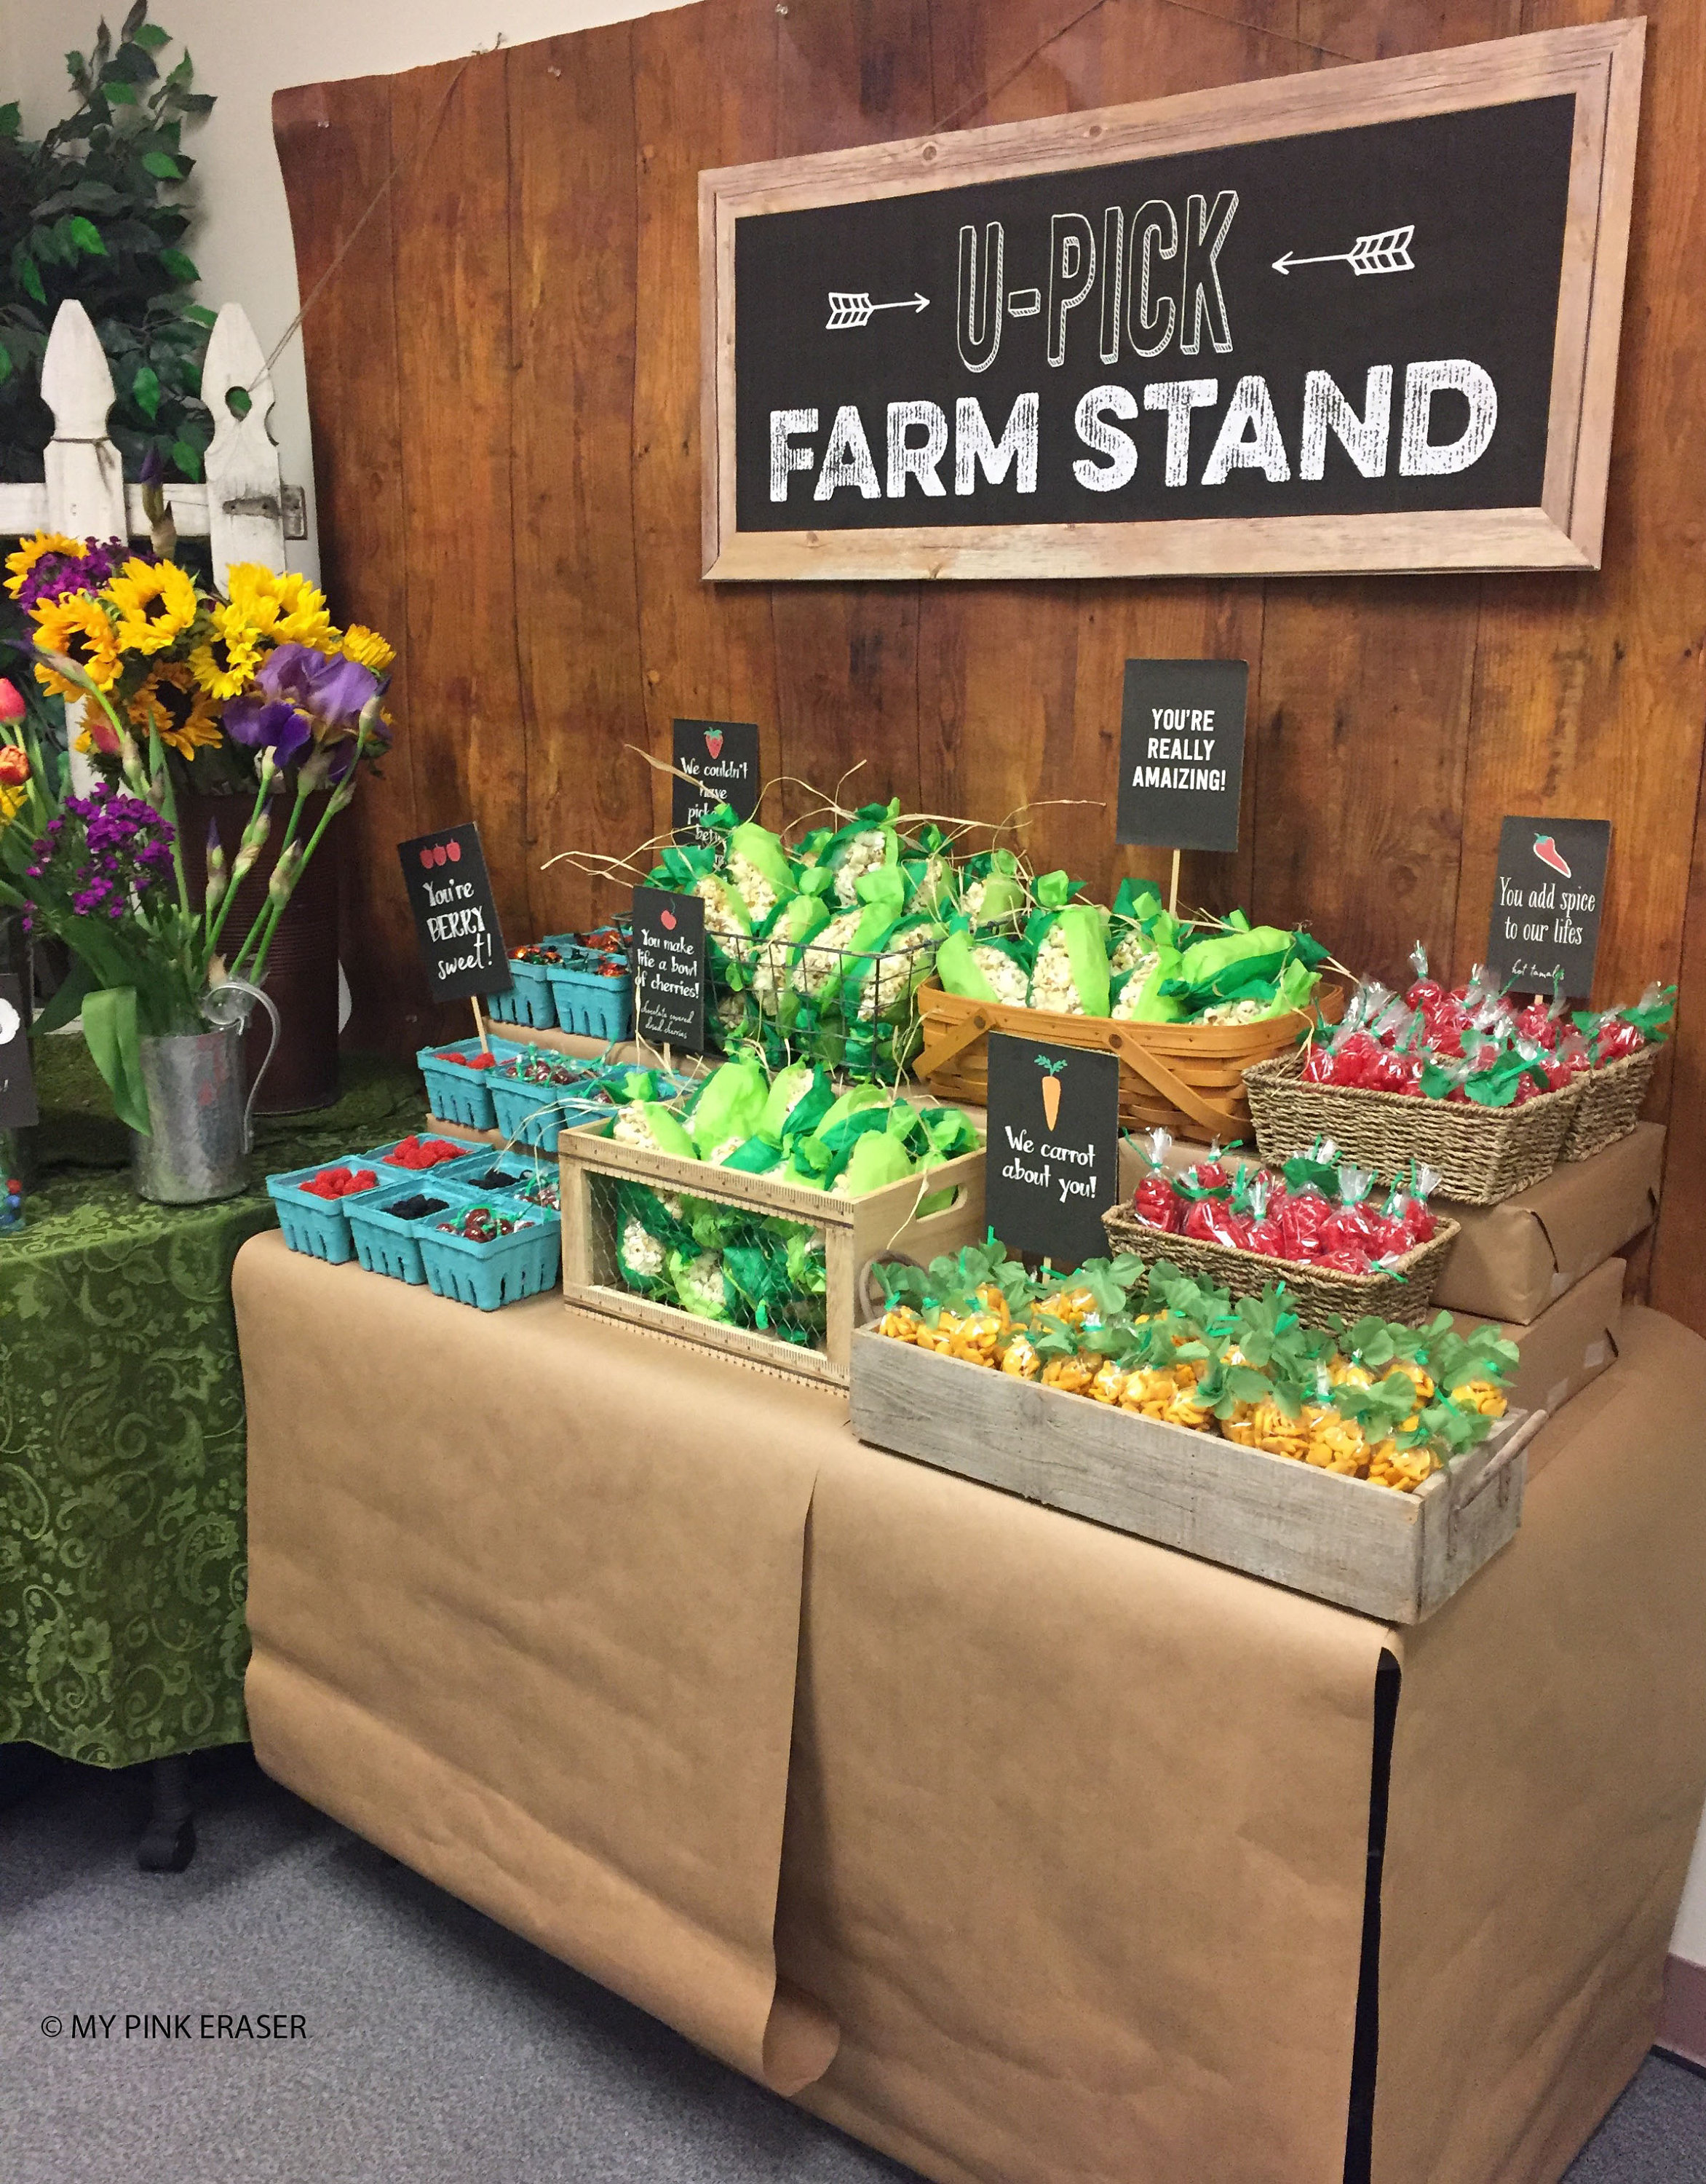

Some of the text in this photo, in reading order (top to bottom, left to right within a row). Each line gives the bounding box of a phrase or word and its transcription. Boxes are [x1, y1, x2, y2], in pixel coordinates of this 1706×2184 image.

[956, 191, 1239, 373] U-PICK
[769, 358, 1498, 502] FARM STAND
[1151, 708, 1215, 732] YOU'RE
[1147, 737, 1215, 761] REALLY
[680, 757, 748, 779] We couldn't
[1132, 766, 1226, 791] AMAIZING!
[422, 879, 475, 906] You're
[1500, 877, 1595, 918] You add spice
[426, 906, 485, 943] BERRY
[1504, 916, 1583, 945] to our lifes
[640, 928, 694, 955] You make
[437, 933, 493, 980] sweet!
[637, 949, 697, 977] life a bowl
[1512, 959, 1565, 980] hot tamals
[651, 973, 699, 999] cherries!
[1004, 1125, 1095, 1168] We carrot
[1001, 1158, 1097, 1203] about you!
